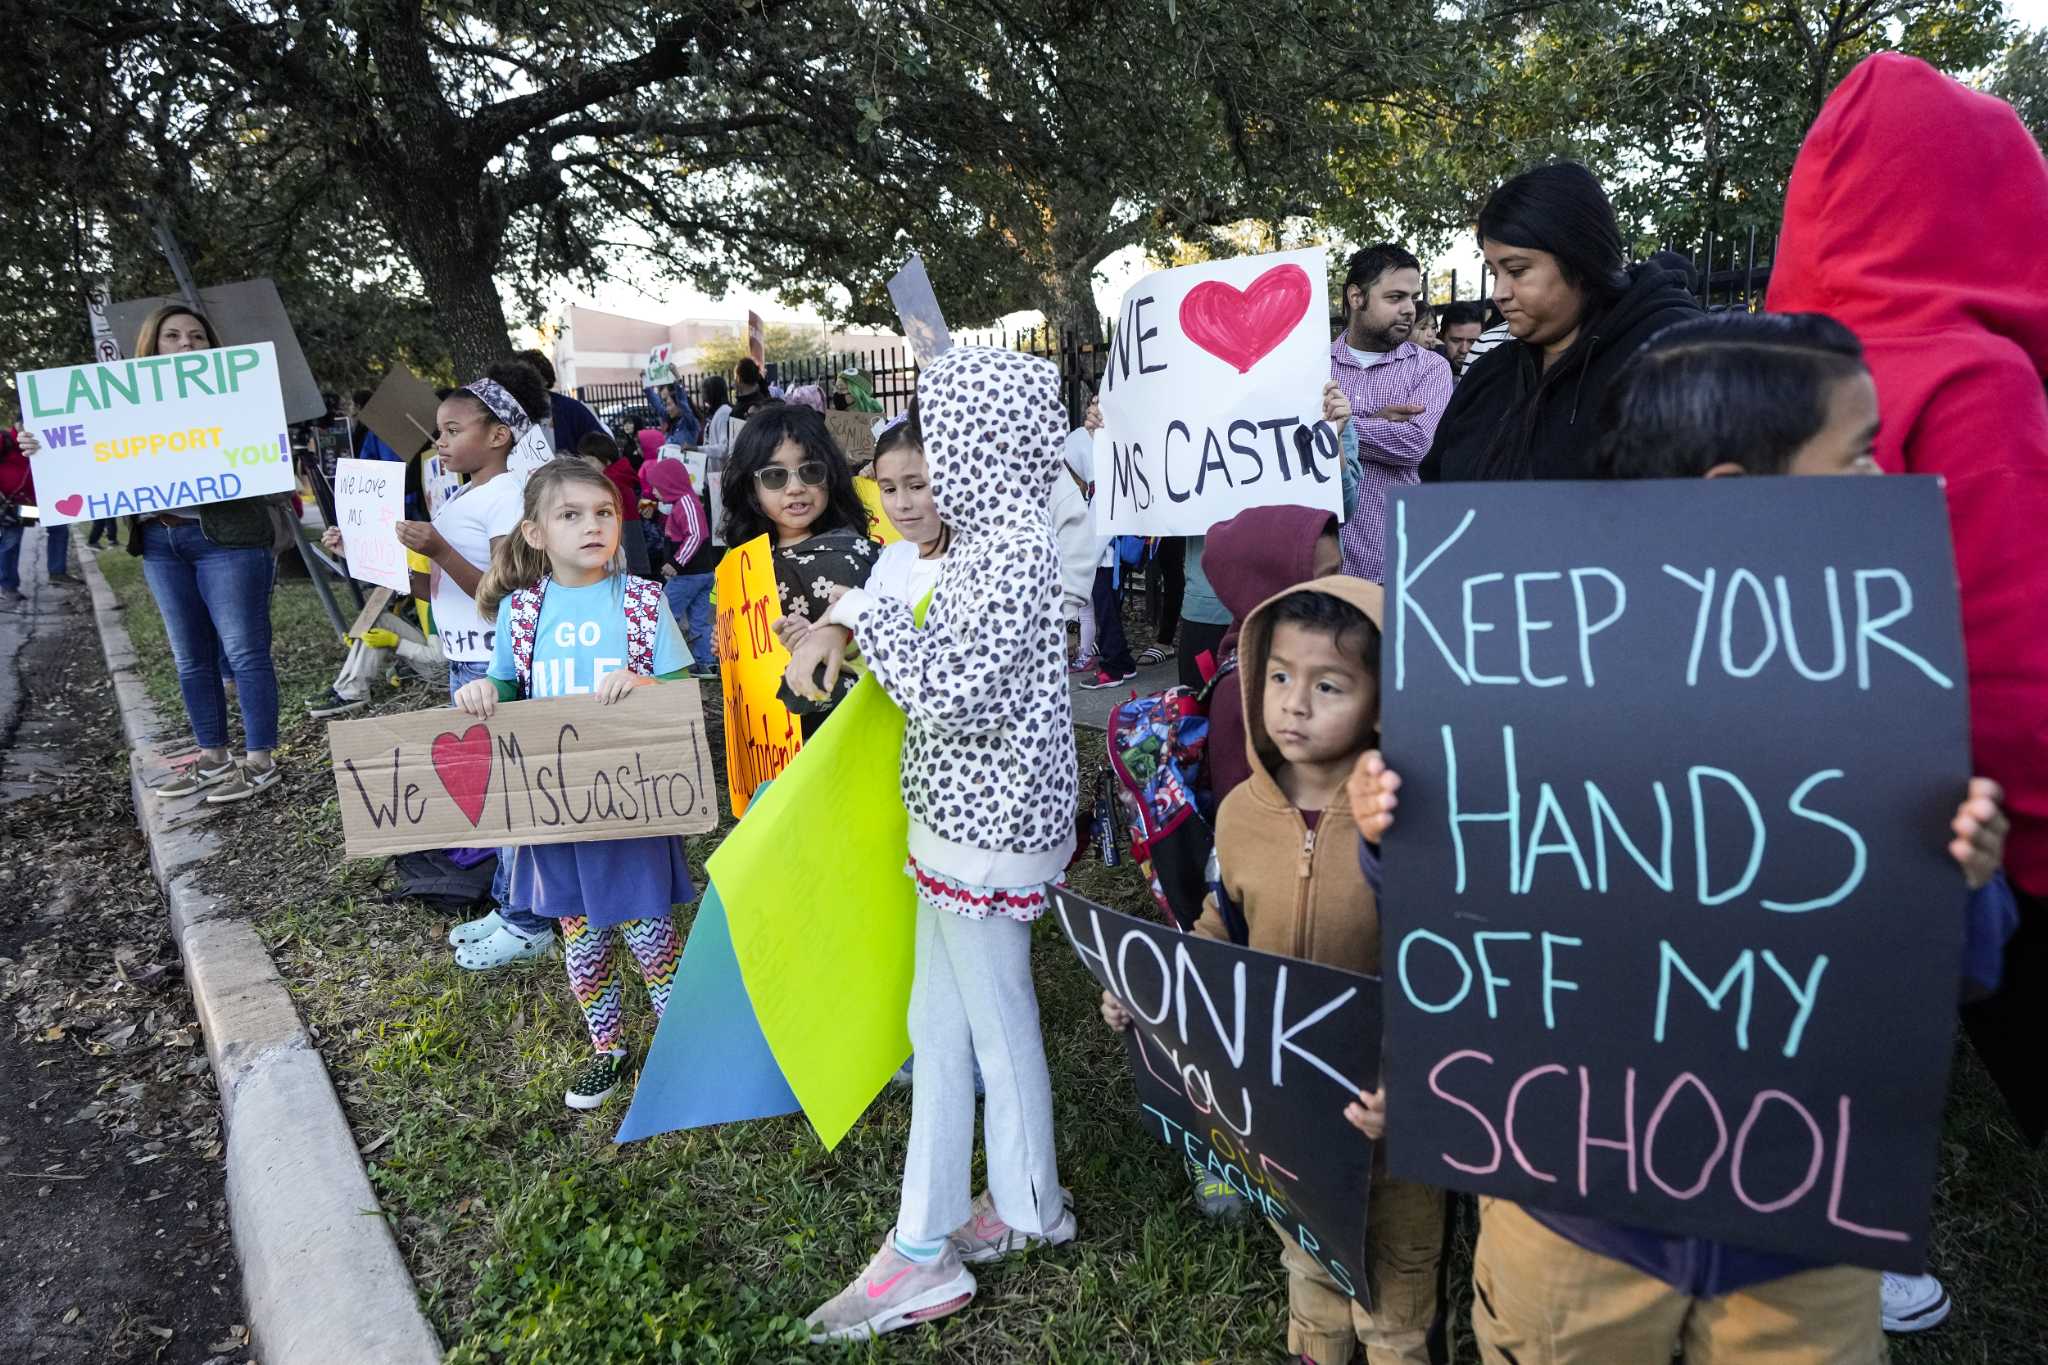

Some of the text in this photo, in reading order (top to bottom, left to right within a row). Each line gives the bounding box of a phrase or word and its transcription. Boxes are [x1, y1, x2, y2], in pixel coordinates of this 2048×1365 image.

[27, 348, 260, 418] LANTRIP
[1108, 296, 1168, 392] WE
[43, 424, 88, 450] WE
[93, 427, 225, 463] SUPPORT
[224, 433, 289, 468] YOU!
[1164, 416, 1339, 503] CASTRO
[88, 473, 242, 519] HARVARD
[554, 621, 601, 648] GO
[741, 550, 773, 659] for
[1394, 500, 1954, 690] KEEP YOUR
[439, 629, 496, 654] stro
[343, 747, 428, 829] We
[1441, 724, 1868, 913] HANDS
[1055, 895, 1366, 1097] HONK
[1398, 928, 1830, 1058] OFF MY
[1427, 1050, 1911, 1242] SCHOOL
